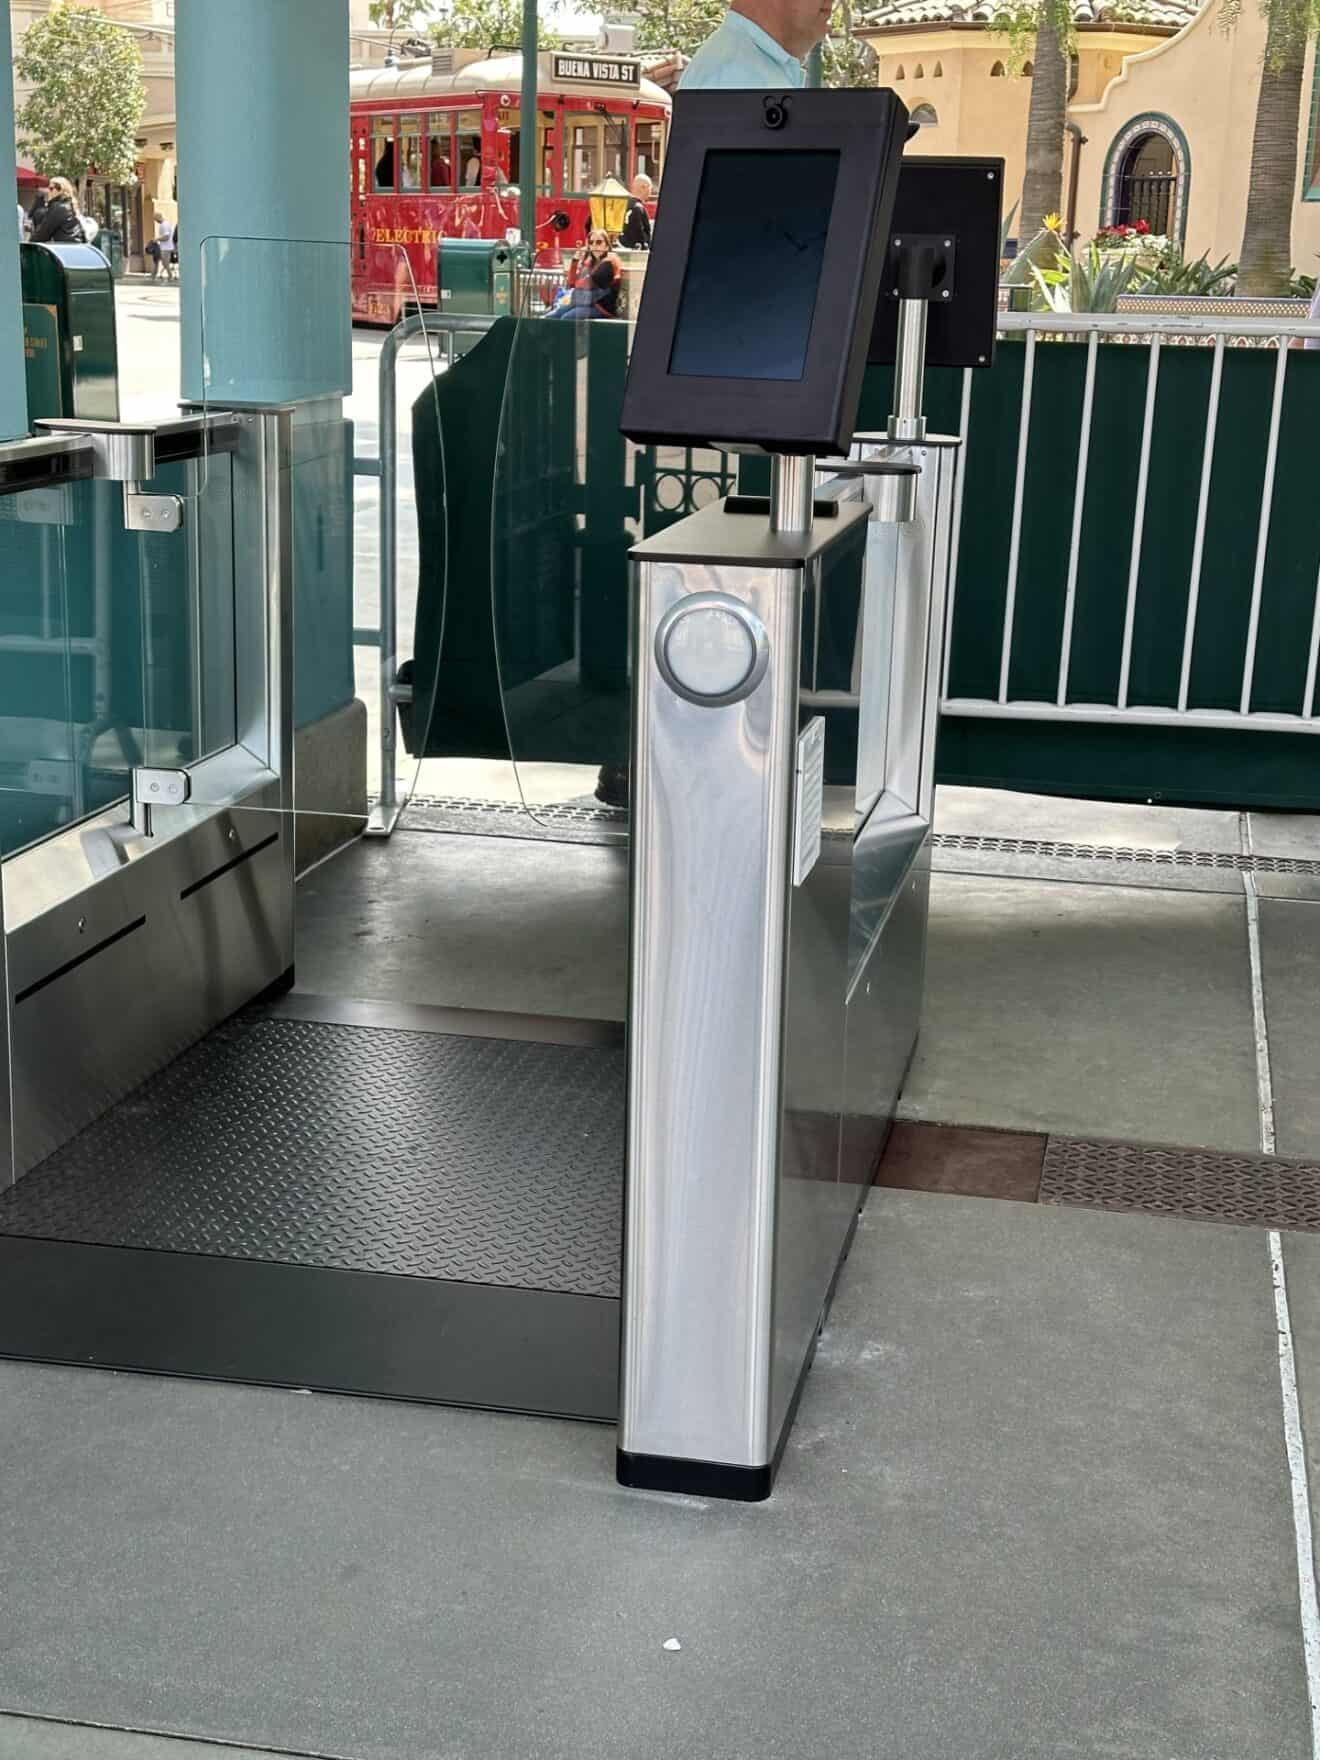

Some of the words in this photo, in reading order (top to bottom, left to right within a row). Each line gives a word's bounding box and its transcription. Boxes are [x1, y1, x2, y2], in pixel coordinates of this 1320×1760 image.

[558, 59, 590, 78] BUENA
[592, 62, 620, 80] VISTA
[621, 64, 635, 81] ST
